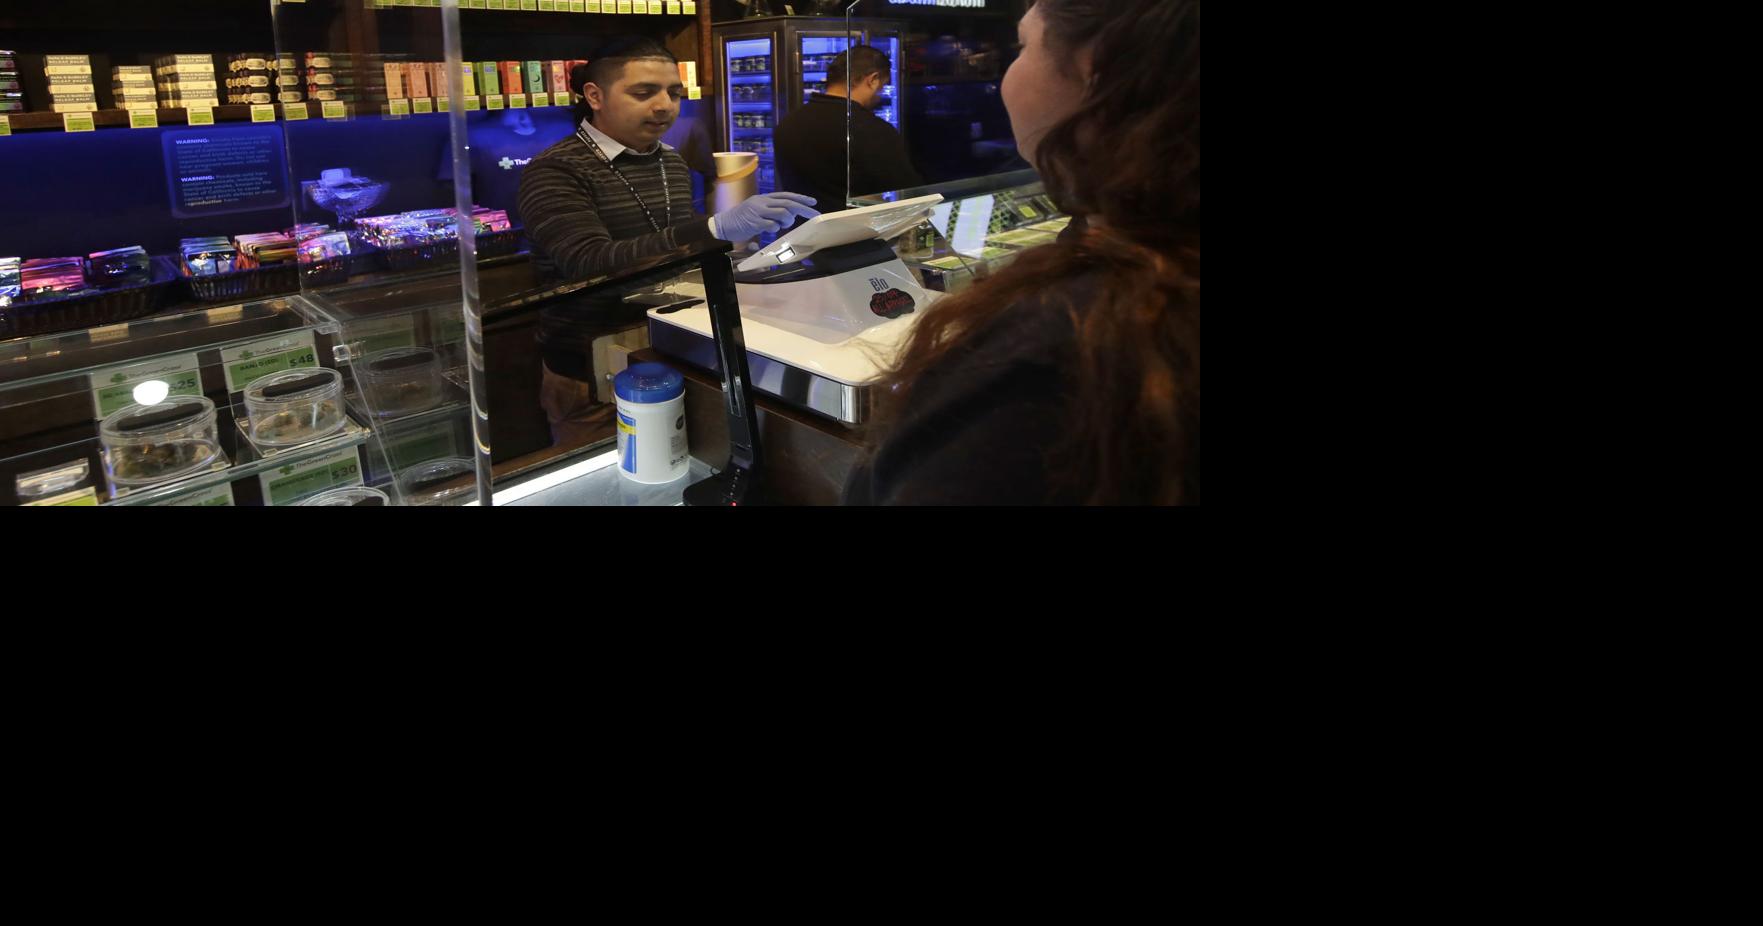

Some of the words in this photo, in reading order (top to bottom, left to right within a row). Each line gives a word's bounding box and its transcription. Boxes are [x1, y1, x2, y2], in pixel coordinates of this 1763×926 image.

[289, 353, 315, 368] $48
[169, 378, 196, 392] $25
[331, 464, 358, 480] $30
